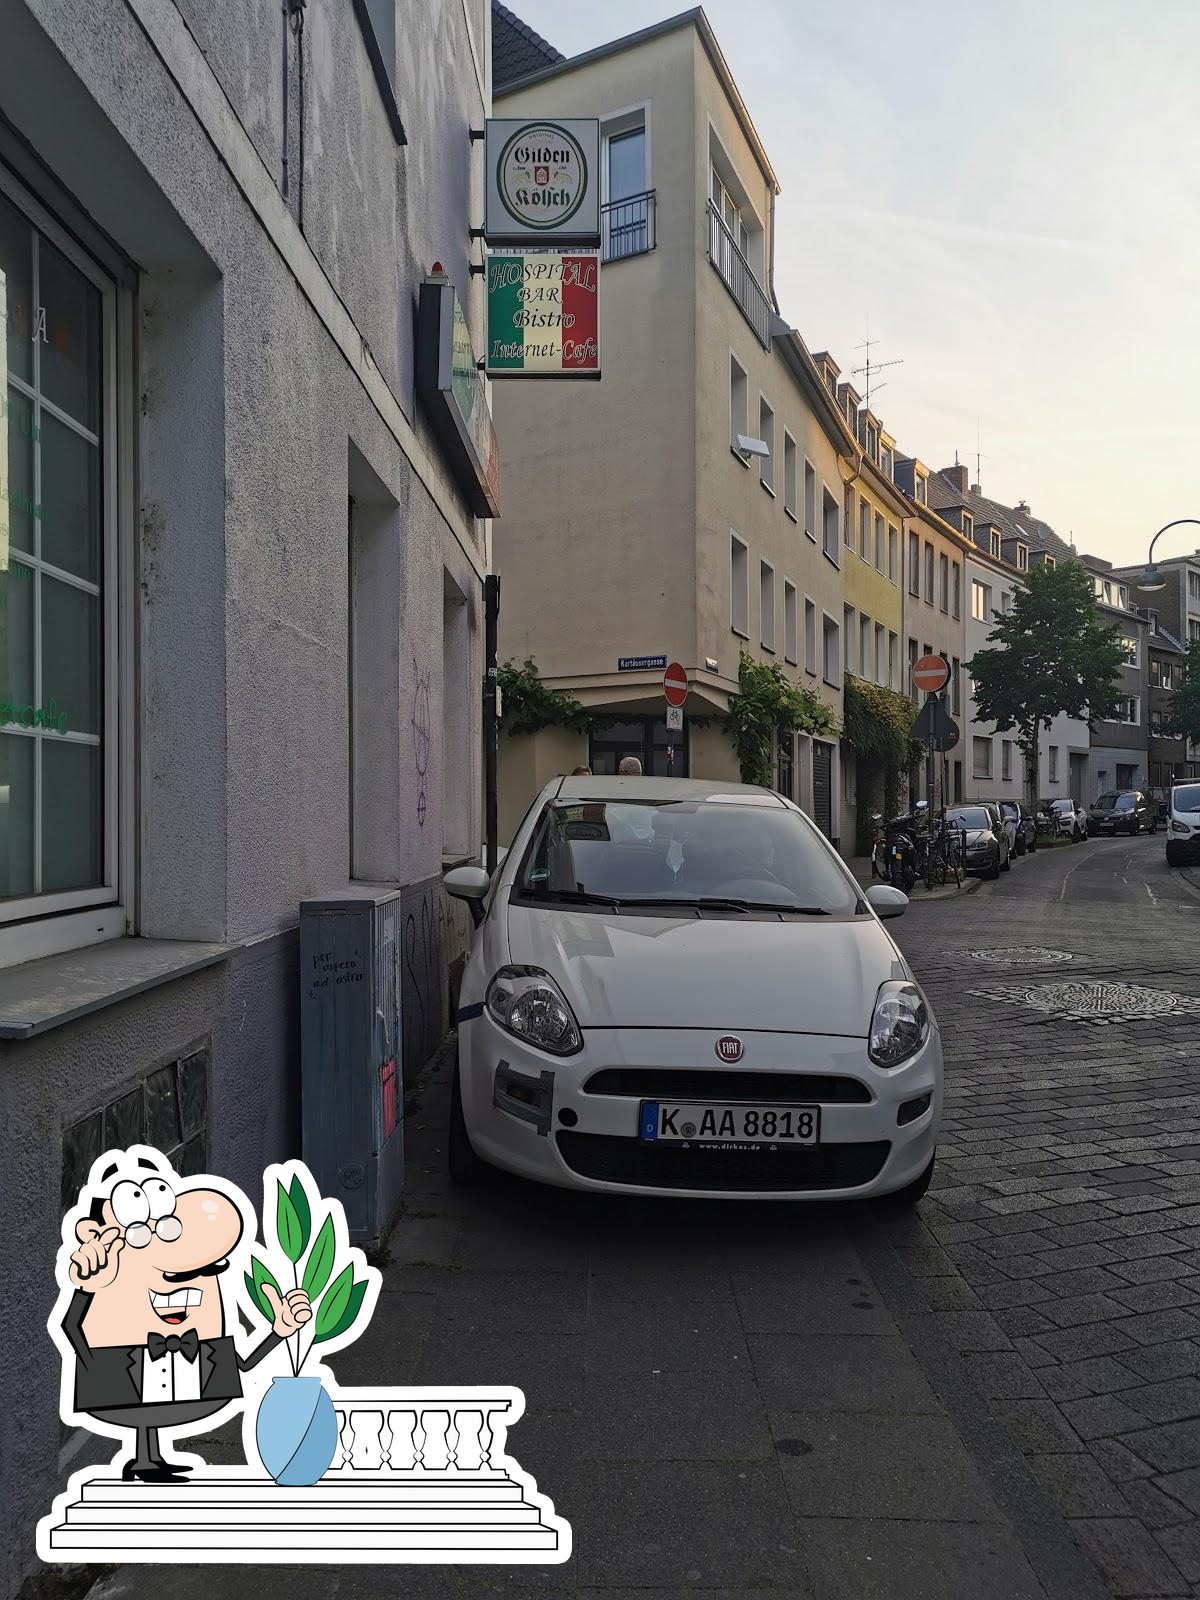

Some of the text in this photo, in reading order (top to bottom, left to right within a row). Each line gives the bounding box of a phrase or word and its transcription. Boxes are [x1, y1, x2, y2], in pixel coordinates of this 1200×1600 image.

[514, 146, 570, 163] Gilden
[489, 261, 596, 293] HOSPITAL
[516, 287, 564, 304] BAR
[512, 308, 575, 328] Bistro
[490, 337, 598, 364] Internet-Cafe
[313, 952, 331, 969] per
[323, 961, 356, 972] aspera
[336, 972, 363, 985] astra
[722, 1042, 739, 1055] FIAT
[646, 1124, 654, 1133] D
[661, 1108, 814, 1139] K AA 8818
